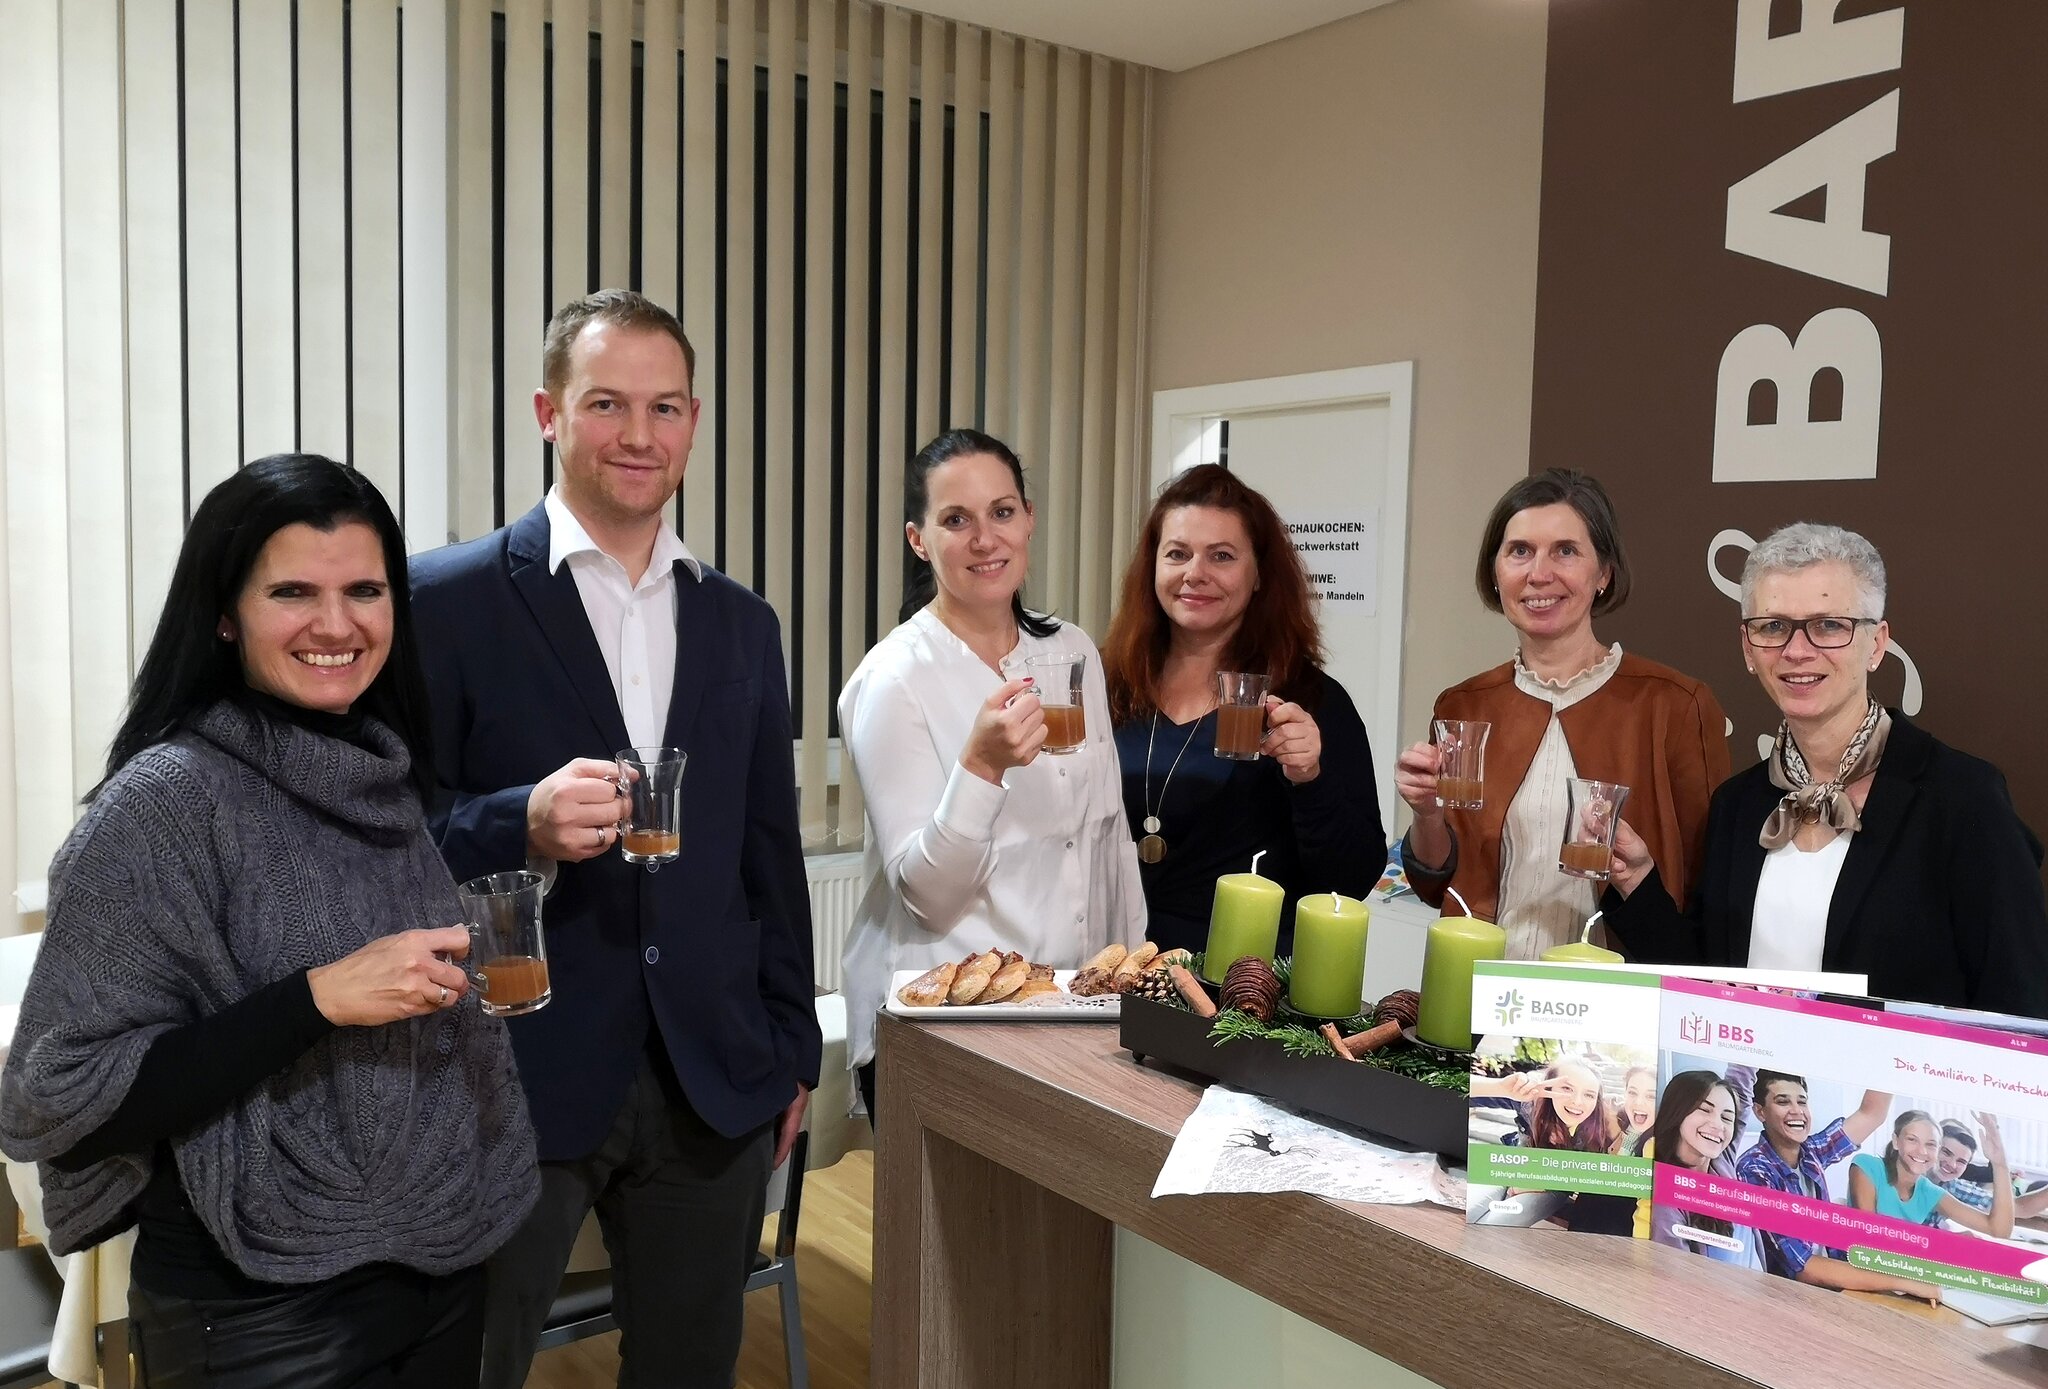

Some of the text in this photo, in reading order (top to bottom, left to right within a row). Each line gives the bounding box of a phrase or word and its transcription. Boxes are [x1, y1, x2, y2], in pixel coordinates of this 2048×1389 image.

[1289, 541, 1360, 551] ackwerkstatt
[1326, 591, 1365, 601] Mandeln
[1531, 1000, 1589, 1017] BASOP
[1718, 1024, 1754, 1044] BBS
[1717, 1041, 1774, 1057] BAUMGARTENBERG
[1893, 1057, 1917, 1072] Die
[1923, 1063, 1978, 1084] familiäre
[1490, 1153, 1529, 1165] BASOP
[1542, 1157, 1560, 1168] Die
[1561, 1158, 1597, 1170] private
[1600, 1162, 1653, 1177] Bildungsa
[1490, 1170, 1515, 1179] 5-jährige
[1516, 1172, 1569, 1183] Berufsausbildung
[1579, 1178, 1604, 1186] sozialen
[1674, 1192, 1751, 1217] Deine Karriere beginnt hier
[1674, 1174, 1697, 1189] BBS
[1709, 1183, 1789, 1212] Berufsbildende
[1791, 1203, 1829, 1222] Schule
[1832, 1213, 1929, 1248] Baumgartenberg
[1677, 1227, 1739, 1248] bbsbaumgartenberg.at
[1855, 1250, 1871, 1264] Top
[1874, 1256, 1924, 1276] Ausbildung
[1935, 1271, 1978, 1285] maximale
